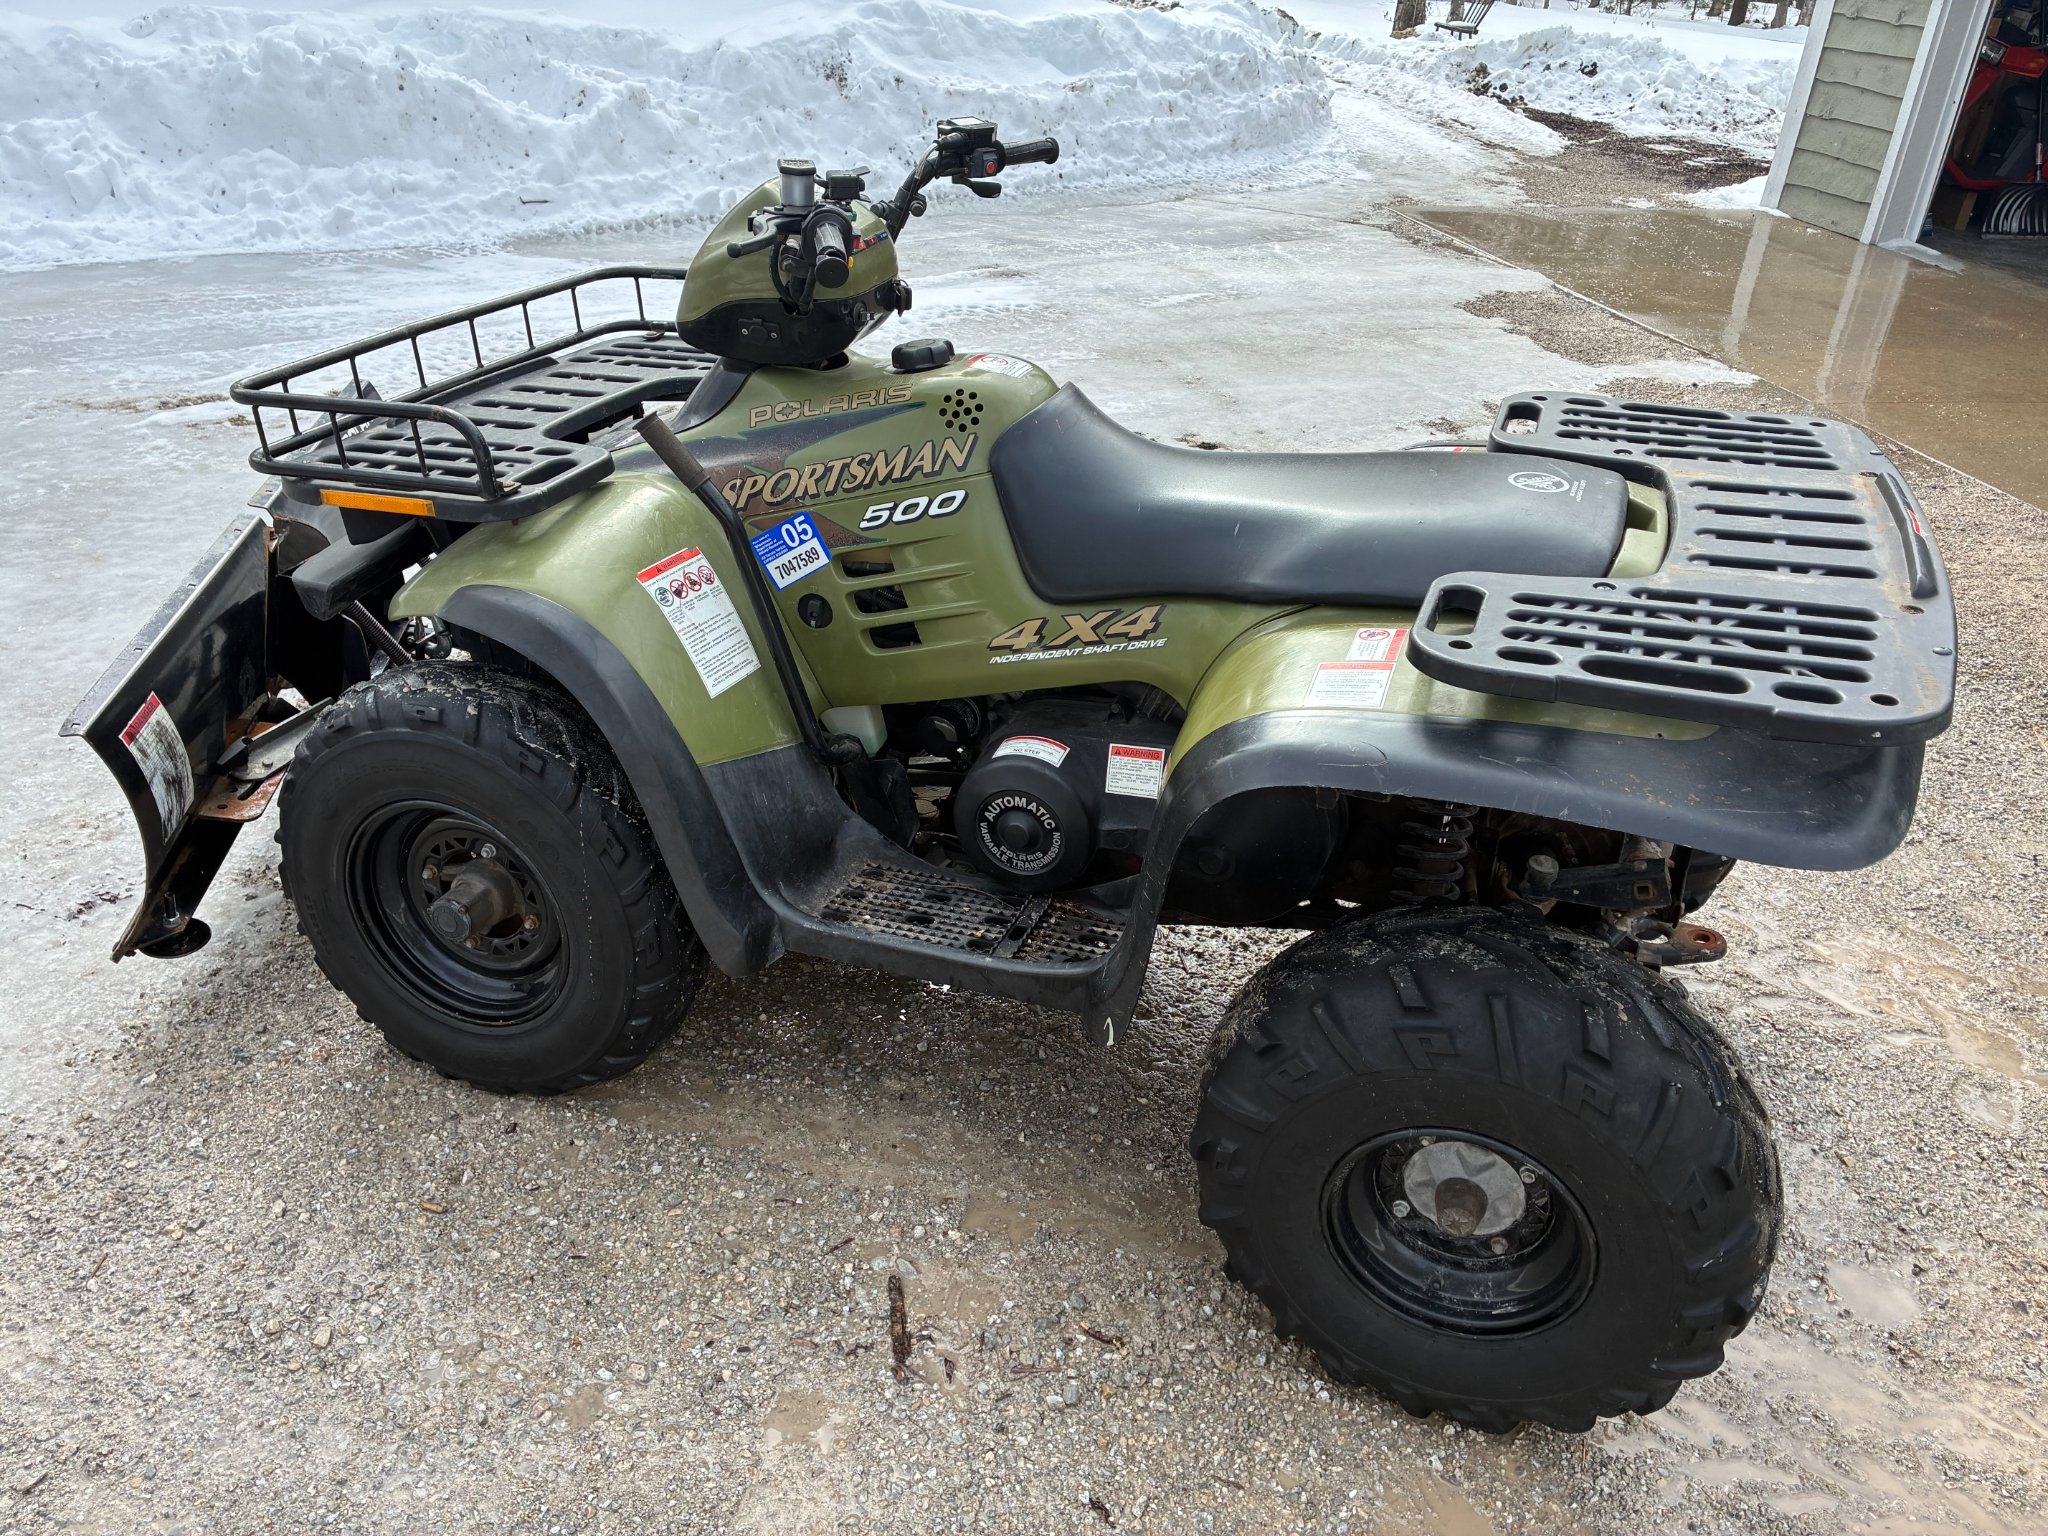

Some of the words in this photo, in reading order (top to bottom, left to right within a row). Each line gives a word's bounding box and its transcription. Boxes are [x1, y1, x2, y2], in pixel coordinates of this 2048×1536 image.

[750, 384, 913, 428] POLARIS
[721, 432, 978, 511] SPORTSMAN
[859, 489, 969, 531] 500
[781, 515, 812, 548] 05
[774, 546, 820, 580] 7047589
[988, 603, 1167, 652] 4X4
[990, 648, 1082, 664] INDEPENDENT
[1082, 643, 1124, 655] SHAFT
[1127, 638, 1168, 650] DRIVE
[1122, 748, 1160, 760] WARNING
[984, 796, 1056, 829] AUTOMATIC
[980, 822, 1008, 862] VARIABLE
[1012, 832, 1060, 869] TRANSMISSION
[1000, 846, 1043, 861] POLARIS
